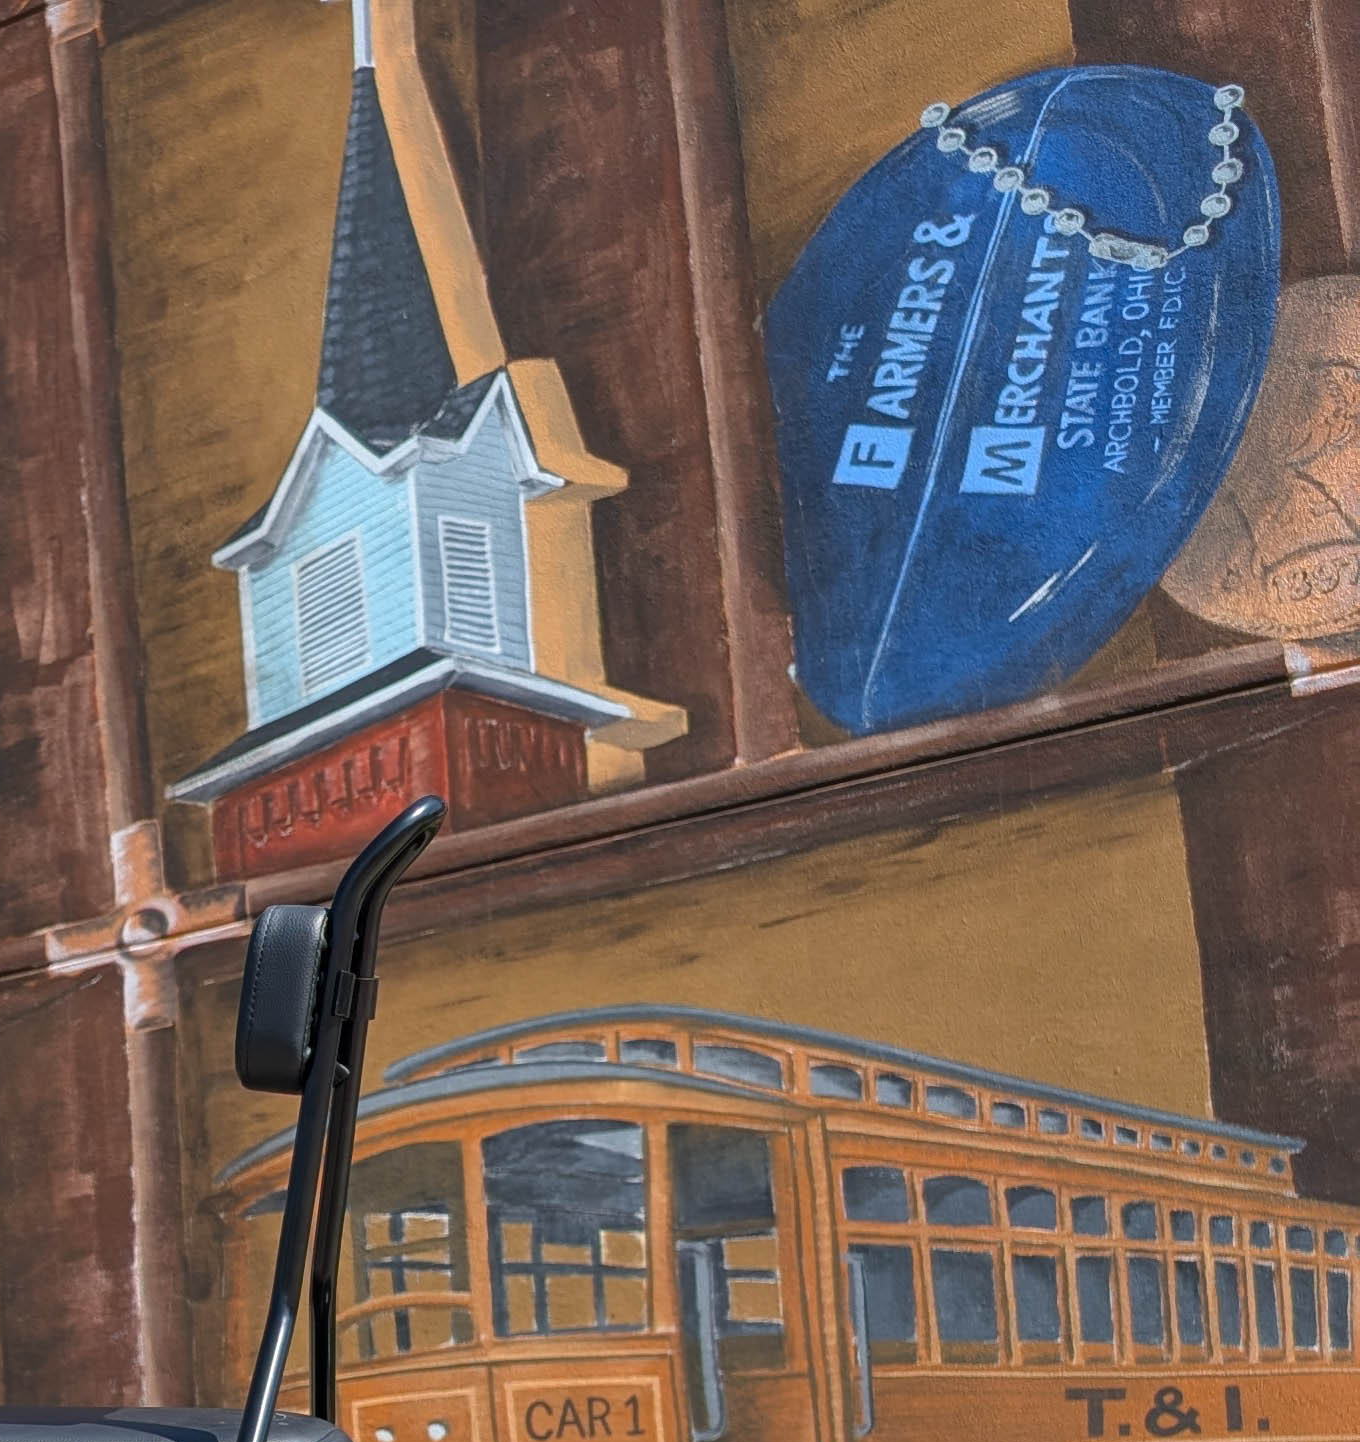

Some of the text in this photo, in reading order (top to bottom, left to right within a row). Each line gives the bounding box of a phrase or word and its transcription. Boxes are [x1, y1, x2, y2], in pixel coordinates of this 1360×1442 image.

[913, 211, 978, 254] &
[826, 320, 865, 384] THE
[1055, 349, 1103, 452] STATE
[1148, 341, 1179, 427] MEMBER
[523, 1393, 647, 1442] CAR 1
[1145, 1385, 1203, 1438] &
